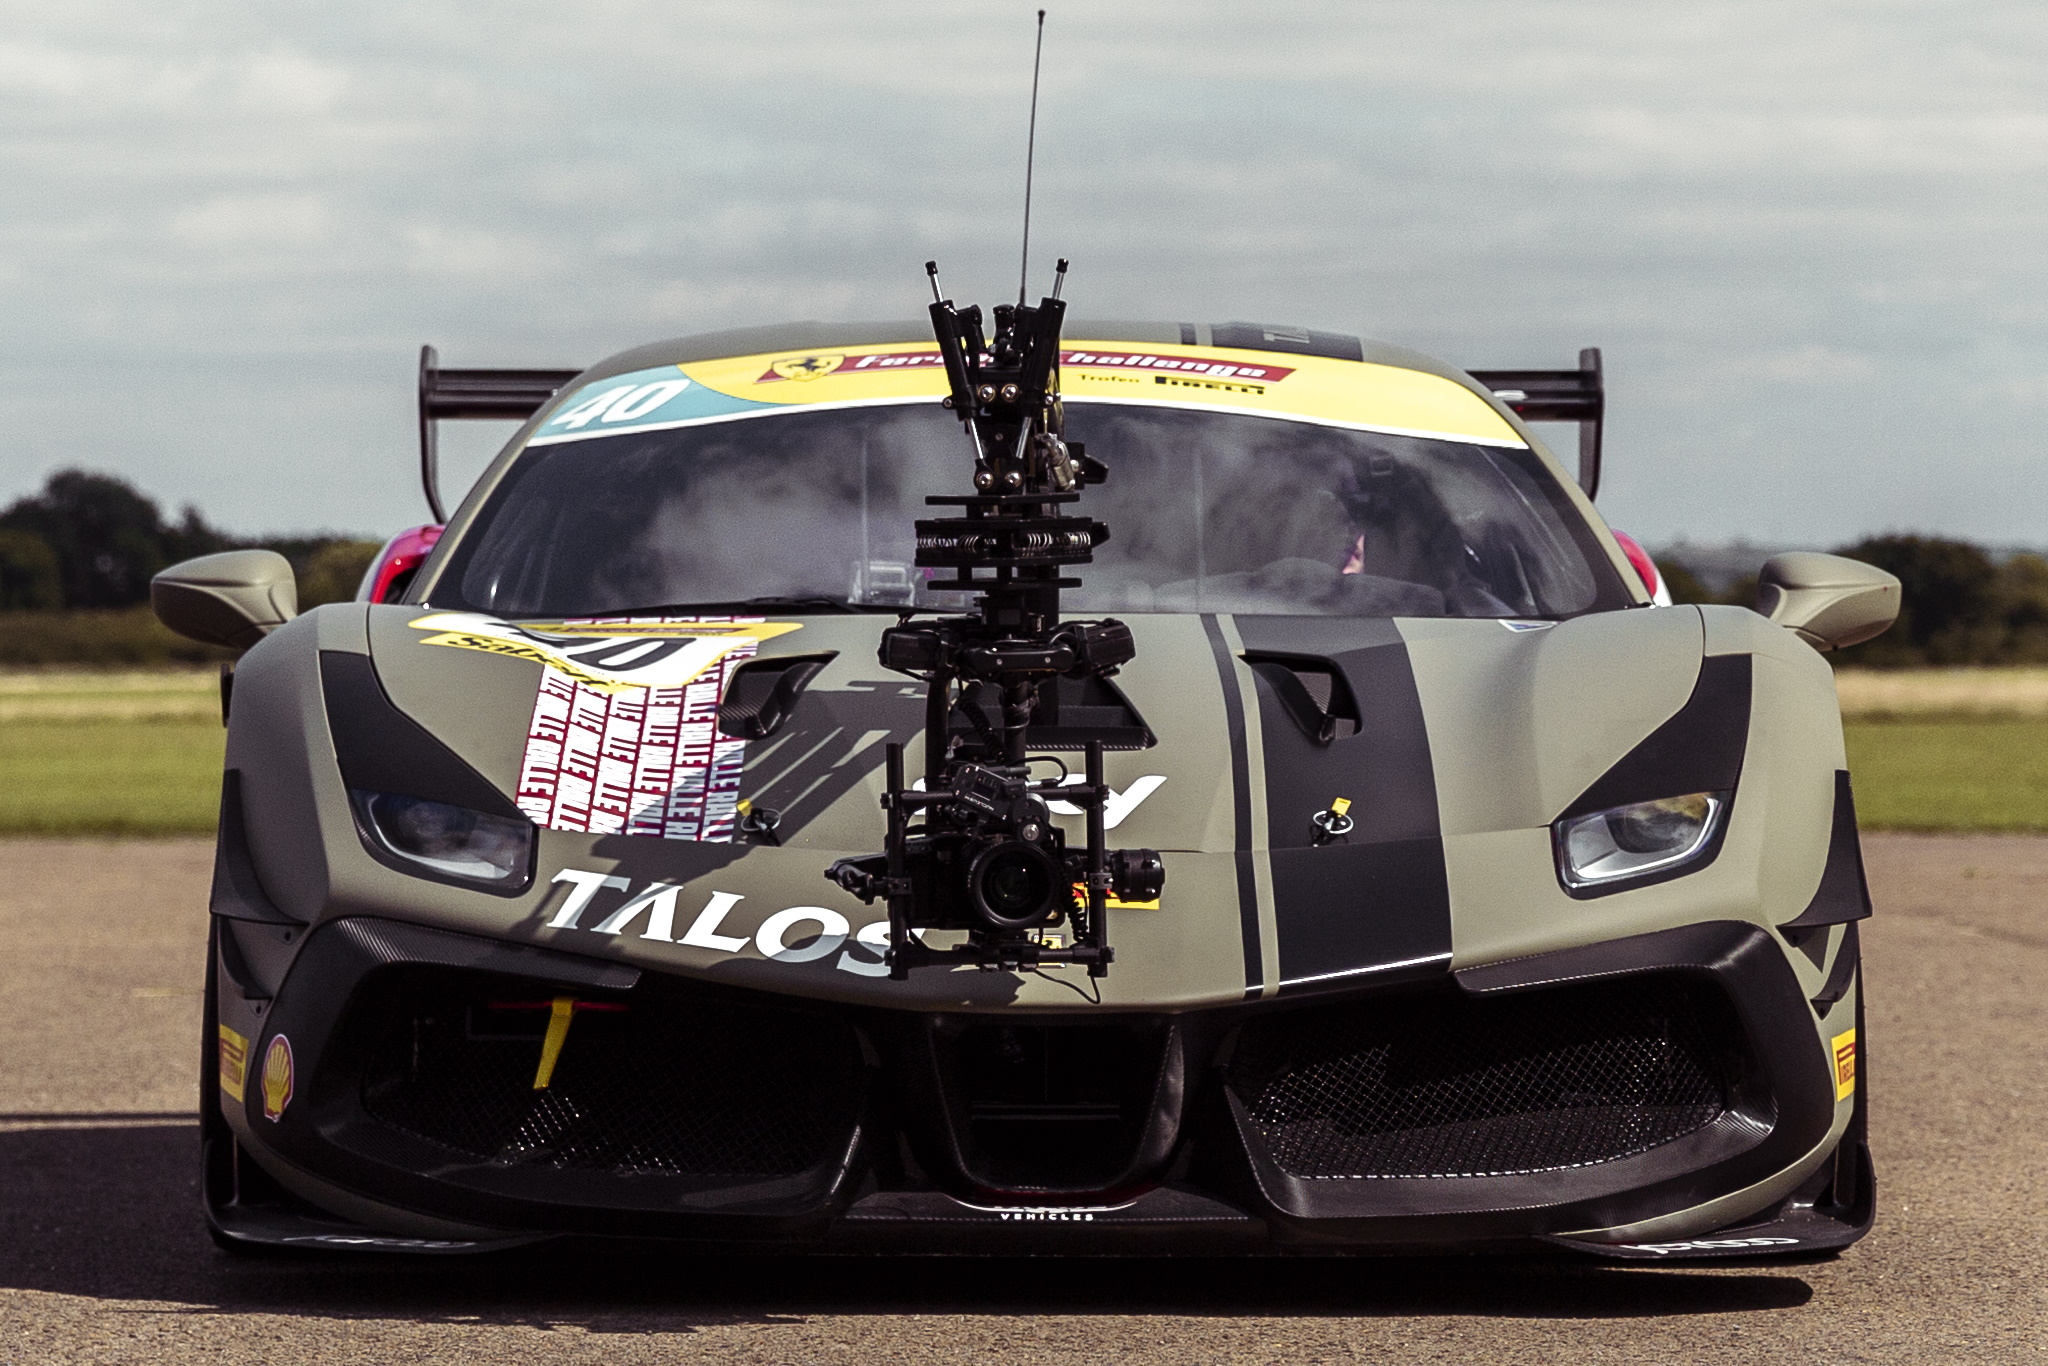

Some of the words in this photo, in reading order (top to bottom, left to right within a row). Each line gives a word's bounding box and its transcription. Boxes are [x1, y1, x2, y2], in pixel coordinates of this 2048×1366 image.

[1066, 352, 1267, 377] hallenge
[1078, 374, 1140, 384] Trofeo
[1155, 376, 1265, 395] PIRELLI
[551, 378, 692, 430] 40
[675, 721, 714, 766] RALLE
[626, 790, 666, 838] RALL
[546, 868, 925, 977] TALOS
[1001, 1213, 1094, 1222] VEHICLES
